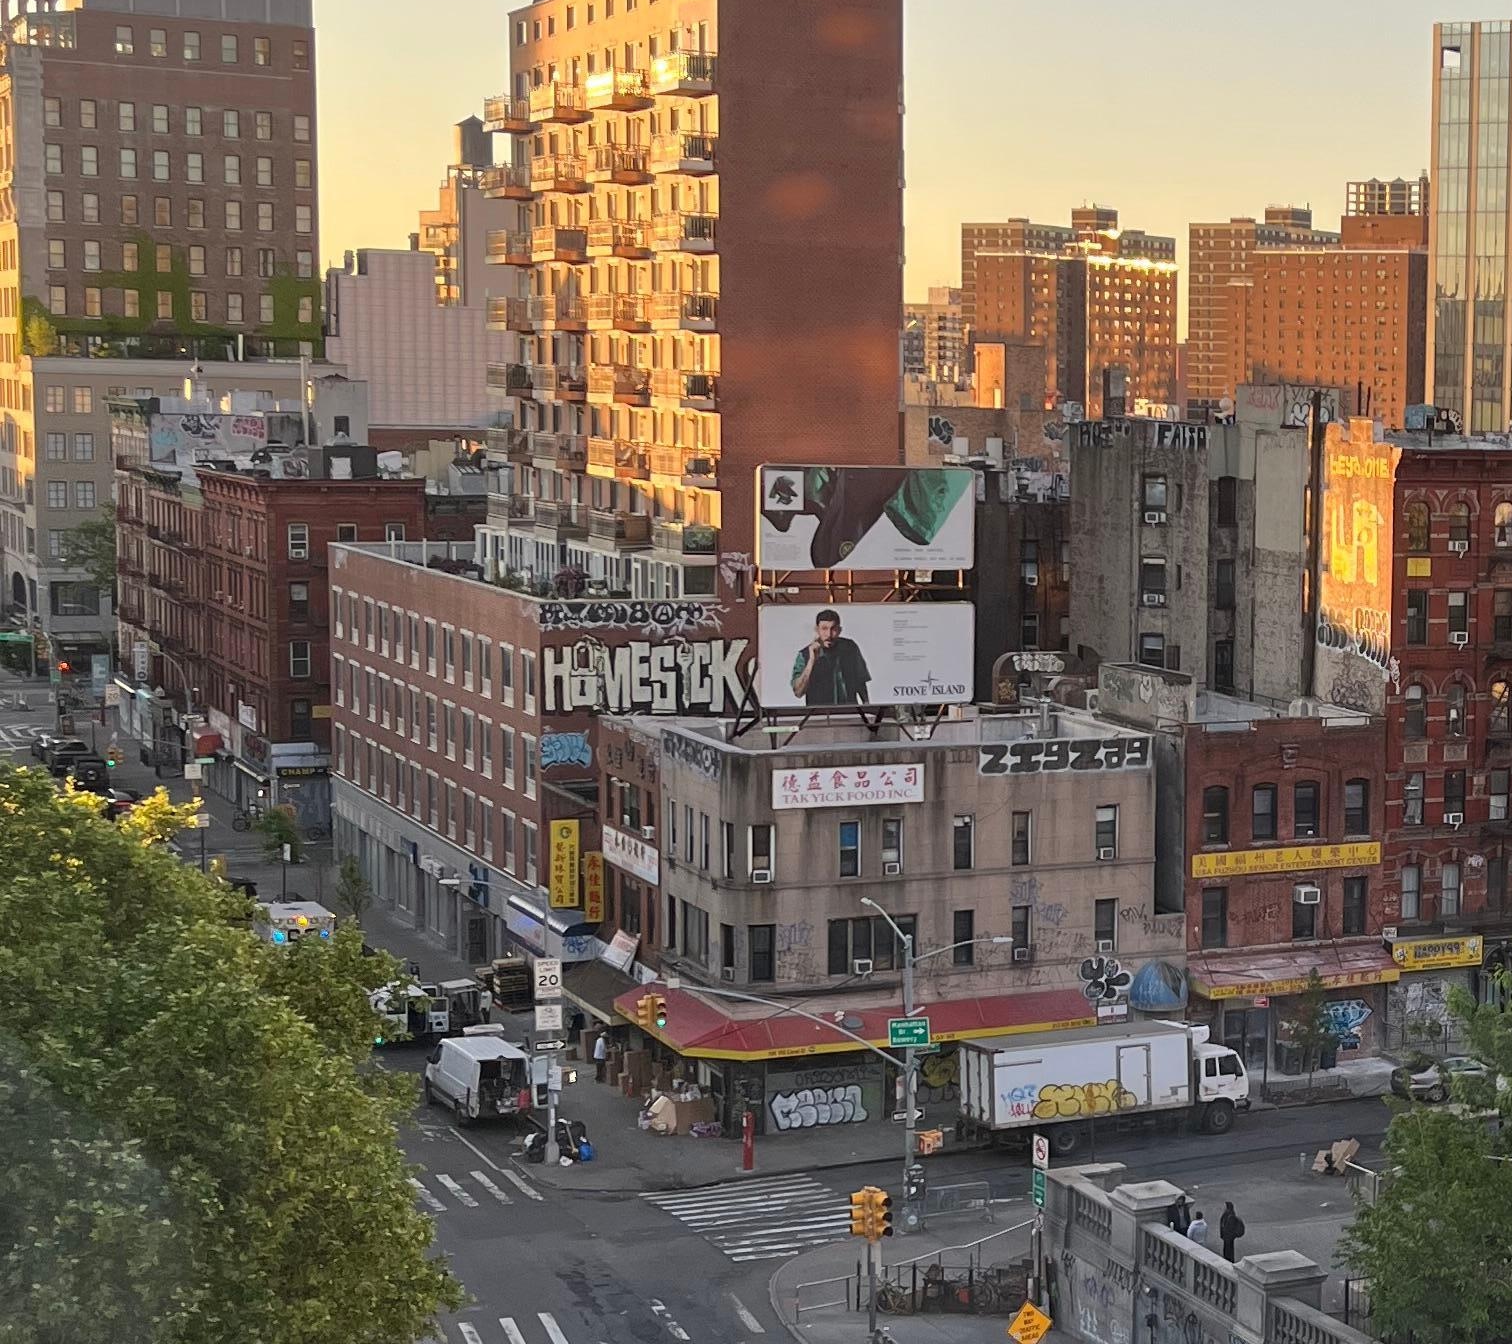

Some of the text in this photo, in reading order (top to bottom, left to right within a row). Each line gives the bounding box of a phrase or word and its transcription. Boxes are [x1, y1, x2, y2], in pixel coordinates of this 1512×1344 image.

[893, 684, 966, 696] STONE ISLAND
[783, 794, 809, 804] TAK
[812, 791, 844, 802] YICK
[847, 789, 885, 801] FOOD
[538, 974, 559, 986] 20
